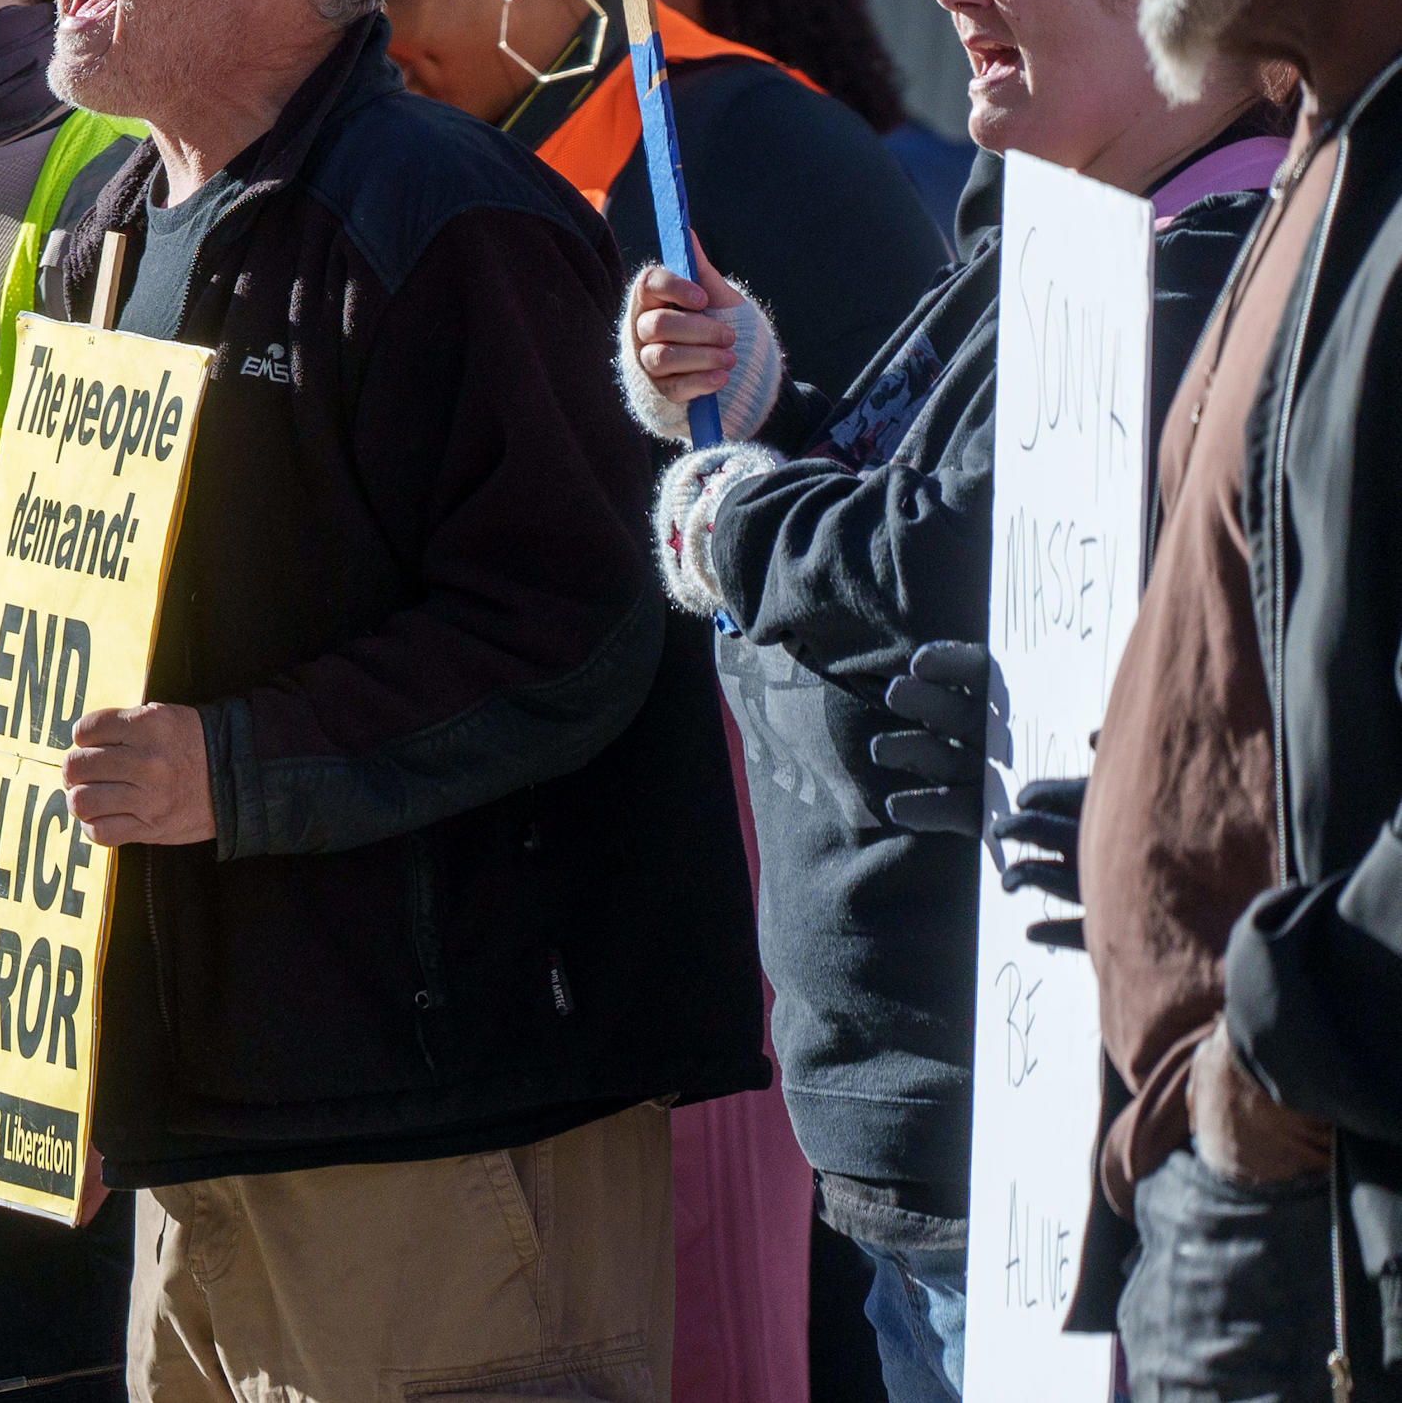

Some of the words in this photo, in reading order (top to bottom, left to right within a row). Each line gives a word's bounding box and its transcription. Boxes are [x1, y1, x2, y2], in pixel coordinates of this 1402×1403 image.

[16, 345, 66, 439] The
[55, 369, 184, 477] people
[240, 354, 291, 385] EMS
[5, 471, 140, 582] demand:
[1004, 505, 1118, 712] MASSEY
[994, 961, 1044, 1088] BE
[3, 1112, 73, 1176] Liberation
